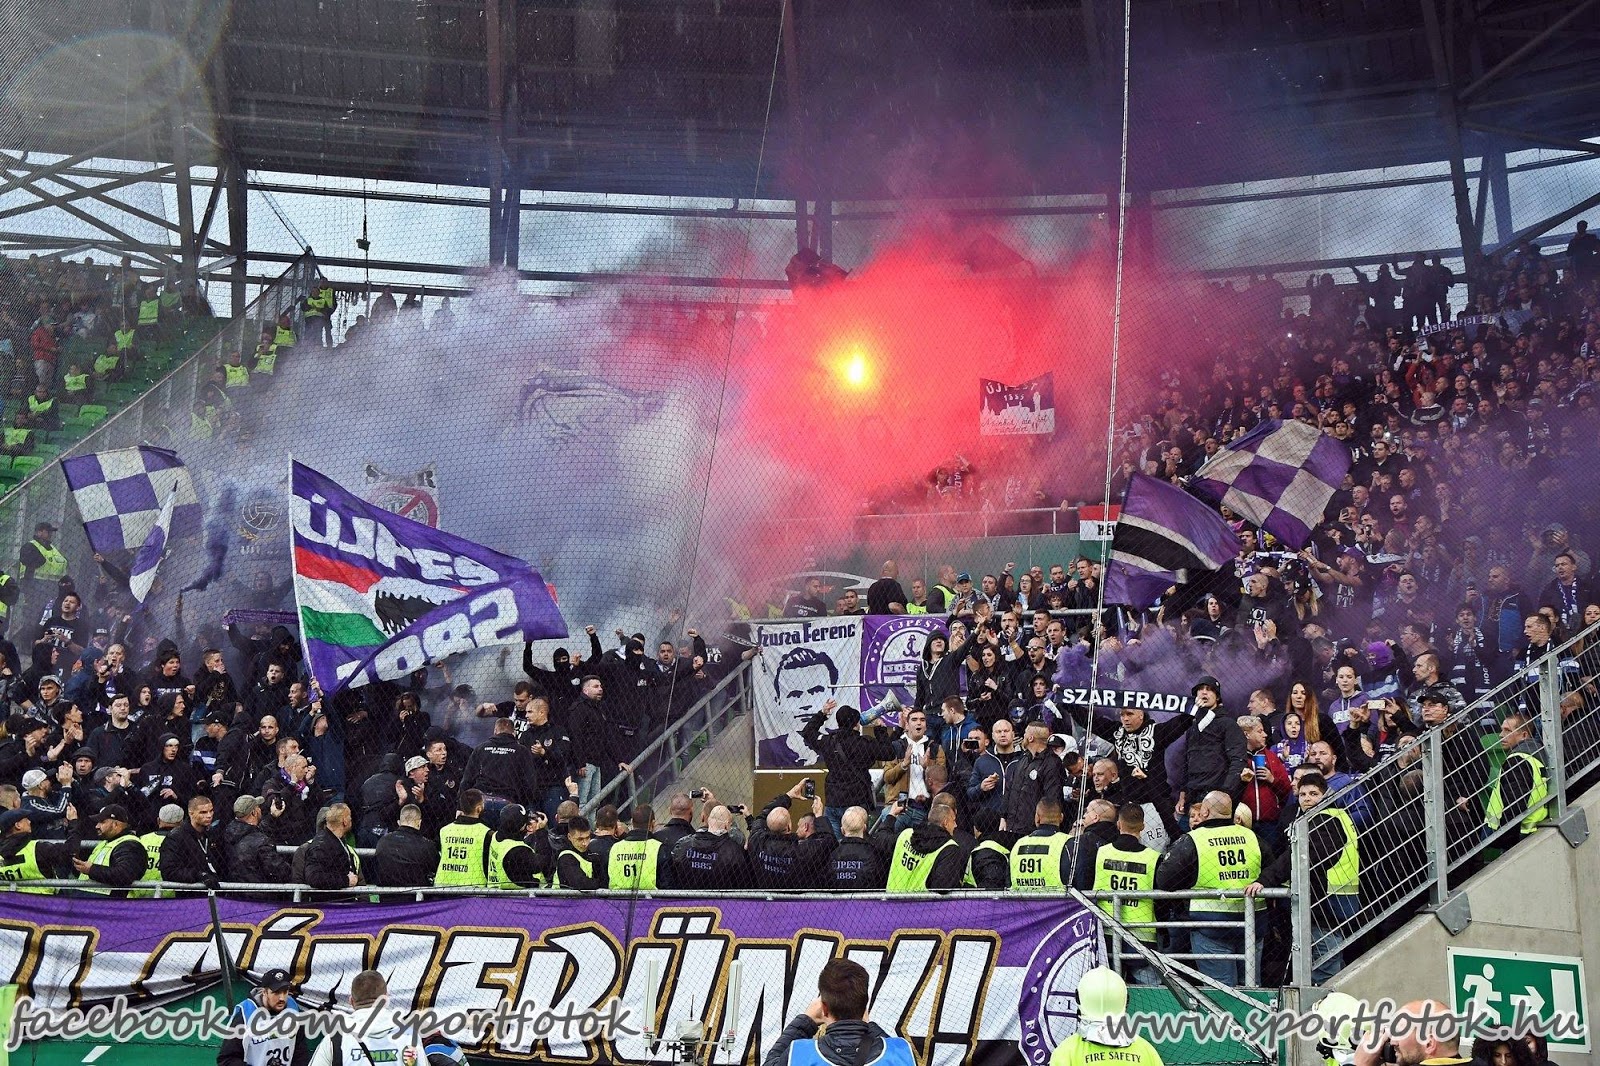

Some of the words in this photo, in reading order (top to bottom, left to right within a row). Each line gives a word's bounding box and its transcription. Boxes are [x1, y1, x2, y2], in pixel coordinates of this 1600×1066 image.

[291, 492, 500, 588] ÚJPES
[803, 622, 857, 643] Ferenc
[1062, 688, 1117, 708] SZAR
[1122, 690, 1188, 712] FRADI
[445, 836, 474, 845] STEWARD
[1208, 836, 1246, 847] STEWARD
[447, 846, 468, 860] 145
[616, 853, 647, 861] STEWARD
[1217, 850, 1247, 867] 684
[901, 852, 920, 872] 561
[1019, 858, 1042, 873] 691
[623, 864, 638, 878] 61
[1110, 874, 1138, 890] 645
[1085, 1053, 1107, 1064] FIRE
[1109, 1051, 1141, 1063] SAFETY
